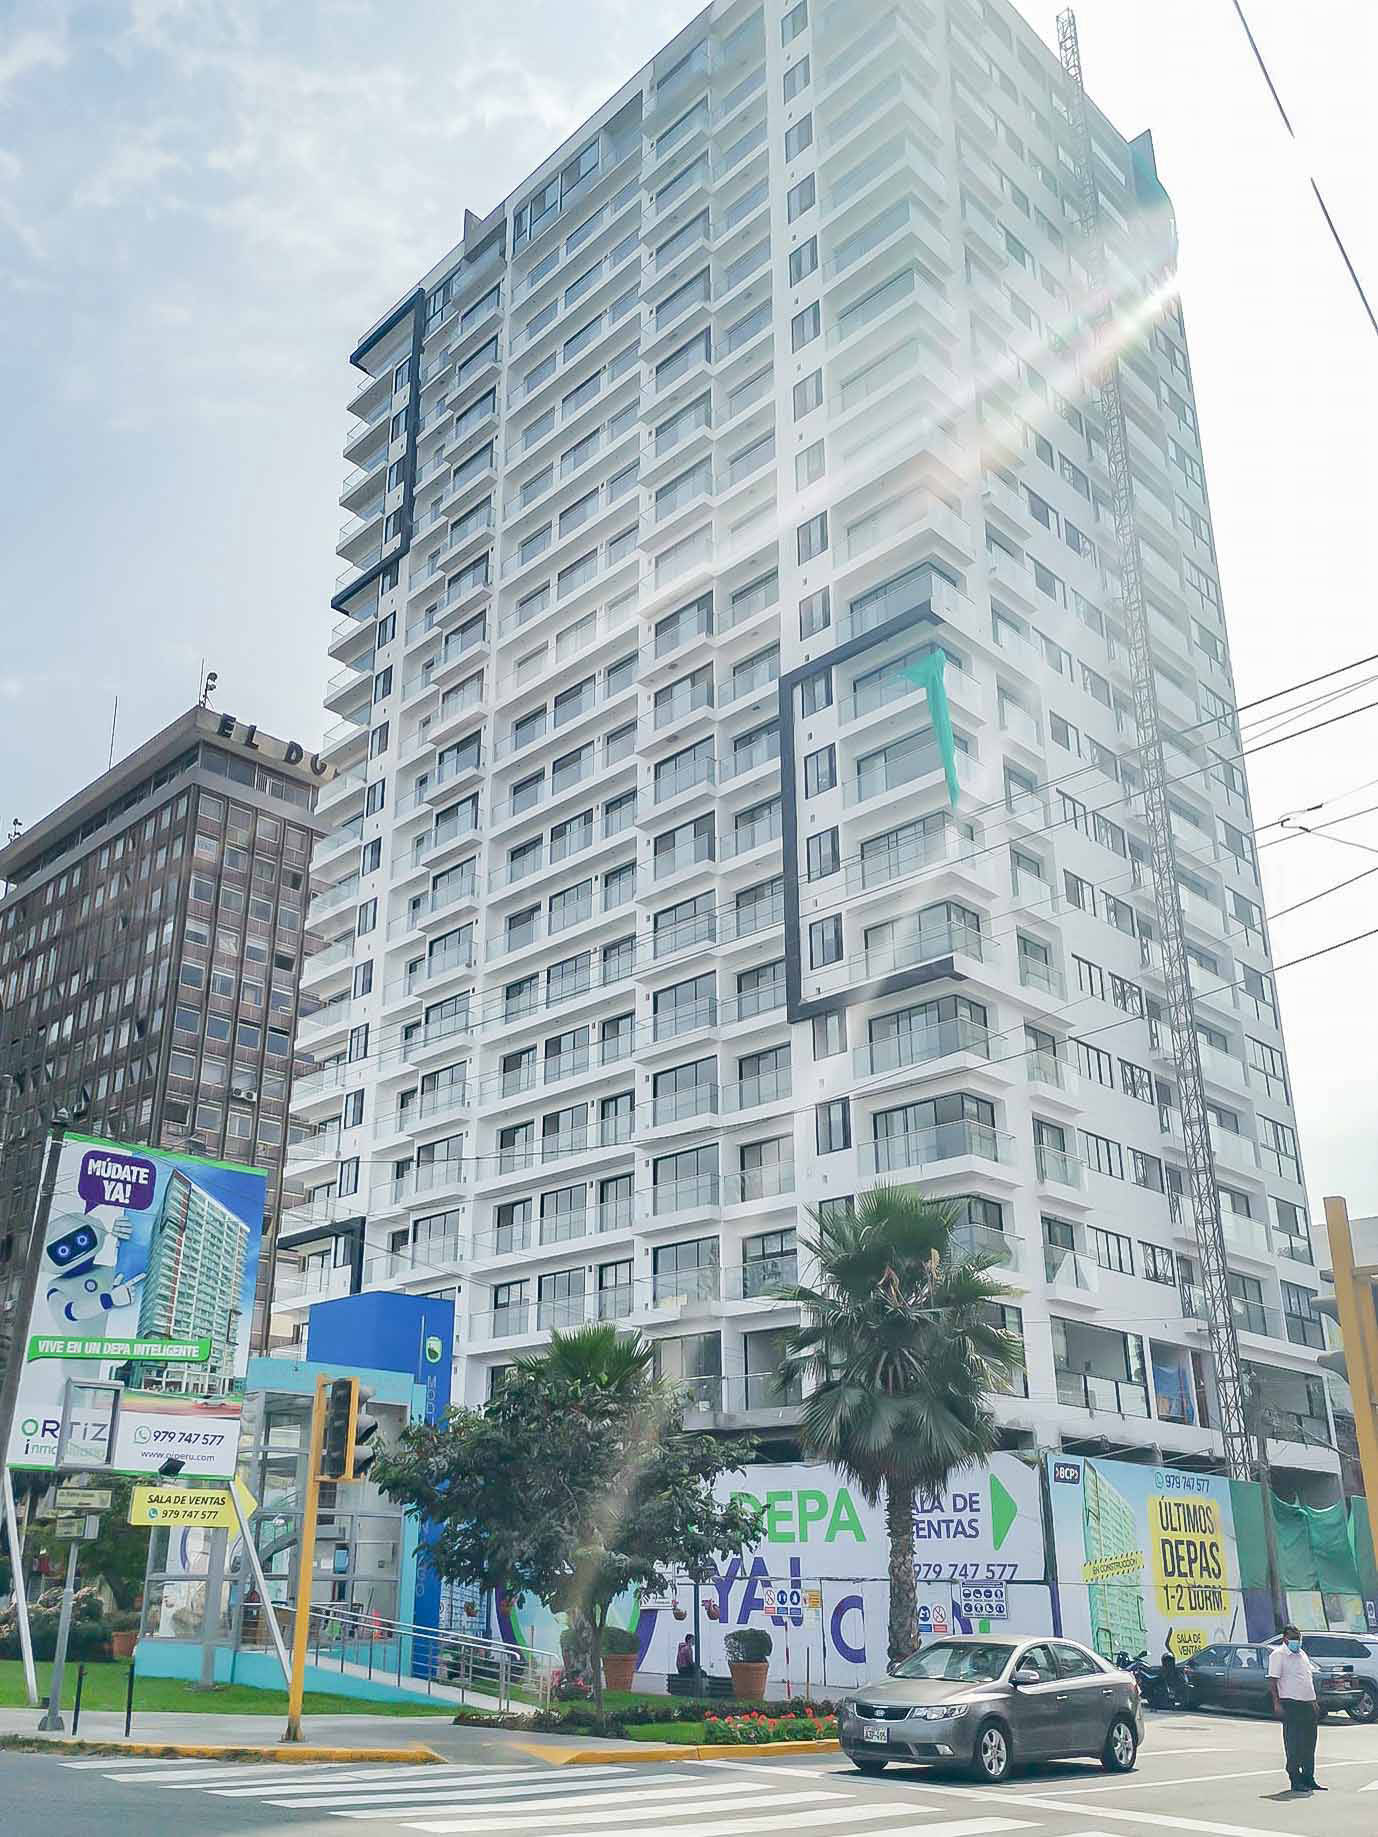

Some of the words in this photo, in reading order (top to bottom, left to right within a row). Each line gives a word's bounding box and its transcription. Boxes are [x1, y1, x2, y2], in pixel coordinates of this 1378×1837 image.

[217, 713, 259, 750] EL
[87, 1158, 150, 1185] MÚDATE
[103, 1180, 132, 1204] YA!
[38, 1340, 64, 1353] VIVE
[67, 1341, 81, 1354] EN
[84, 1342, 100, 1354] UN
[103, 1342, 130, 1355] DEPA
[133, 1344, 200, 1358] INTELIGENTE
[153, 1430, 176, 1442] 979
[178, 1432, 200, 1444] 747
[202, 1434, 224, 1446] 577
[1059, 1466, 1075, 1480] BCP
[1165, 1474, 1181, 1489] 979
[1182, 1476, 1195, 1491] 747
[1196, 1478, 1210, 1493] 577
[147, 1494, 172, 1505] SALA
[174, 1495, 187, 1506] DE
[188, 1496, 226, 1507] VENTAS
[951, 1492, 981, 1513] DE
[162, 1509, 180, 1520] 979
[181, 1510, 199, 1521] 747
[200, 1511, 219, 1522] 577
[1159, 1495, 1215, 1535] ÚLTIMOS
[912, 1519, 980, 1539] ENTAS
[1161, 1538, 1222, 1580] DEPAS
[948, 1563, 980, 1580] 747
[985, 1563, 1019, 1580] 577
[1163, 1583, 1185, 1611] 1-2
[1176, 1633, 1193, 1644] SALA
